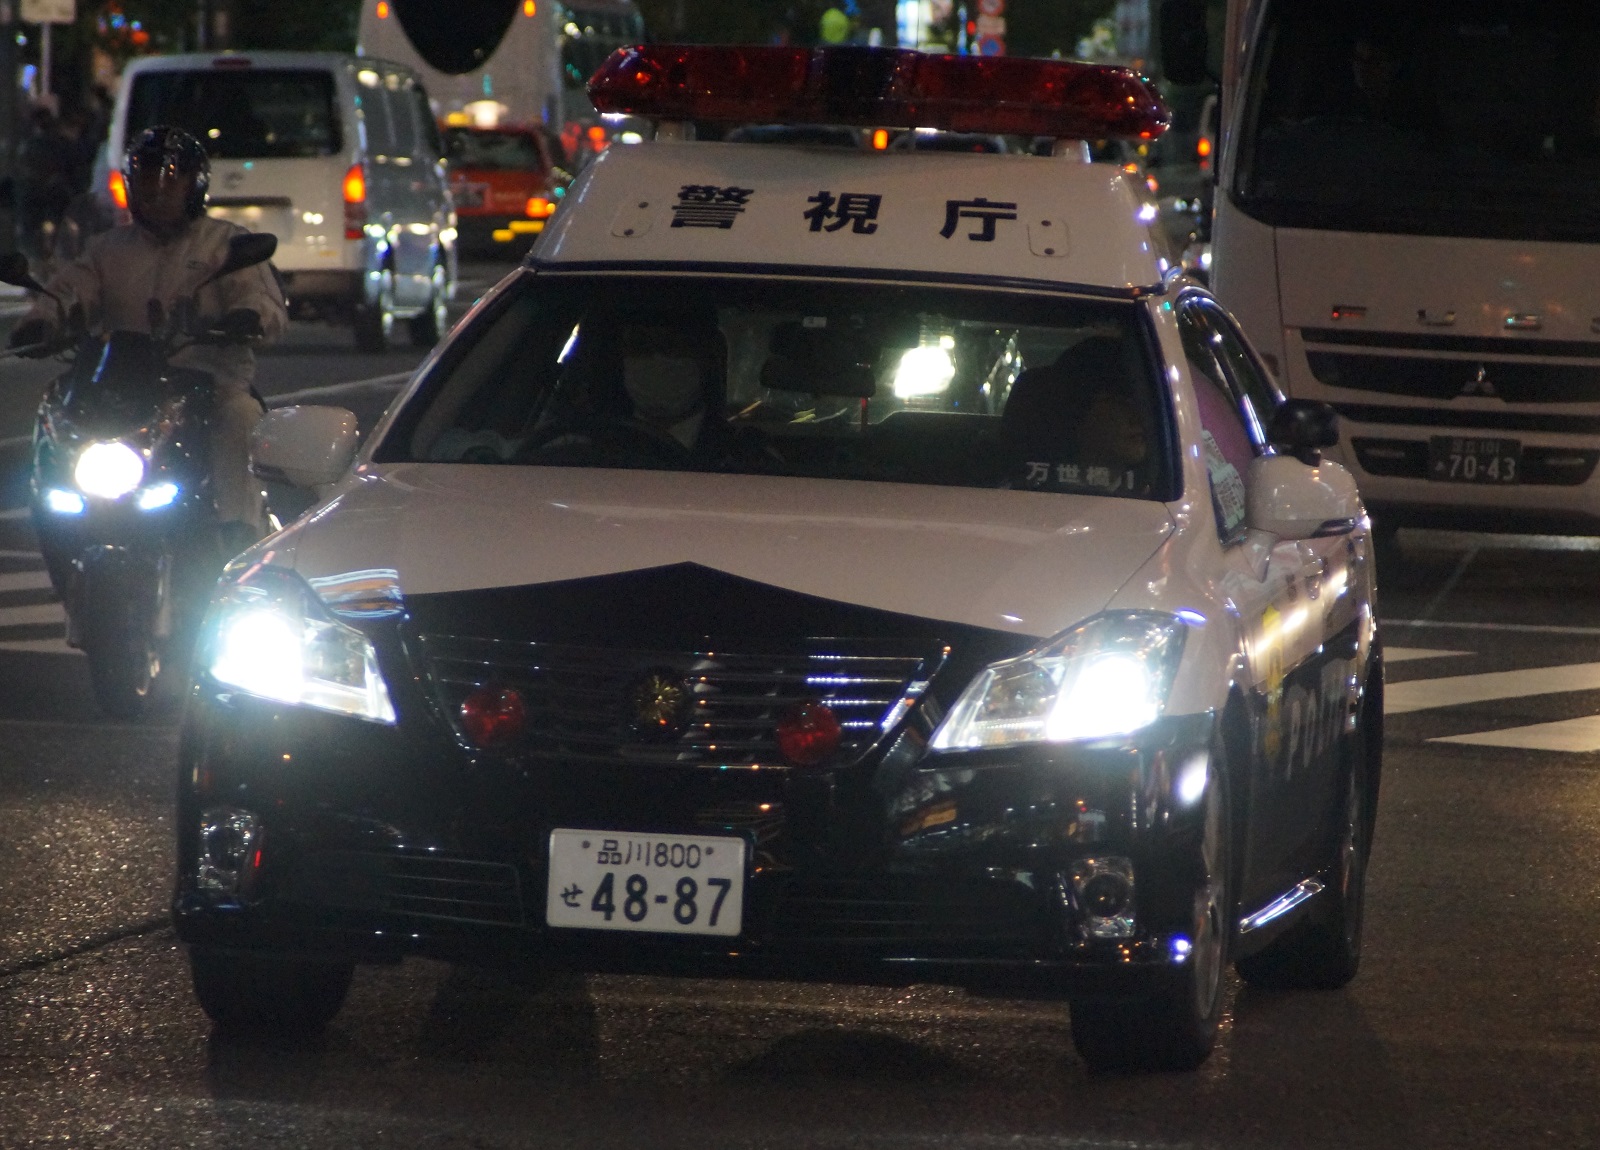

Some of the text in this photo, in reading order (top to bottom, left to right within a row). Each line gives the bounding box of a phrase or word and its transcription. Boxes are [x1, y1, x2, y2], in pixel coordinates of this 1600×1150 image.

[670, 184, 1018, 242] 警視庁
[1449, 454, 1516, 480] 70-43
